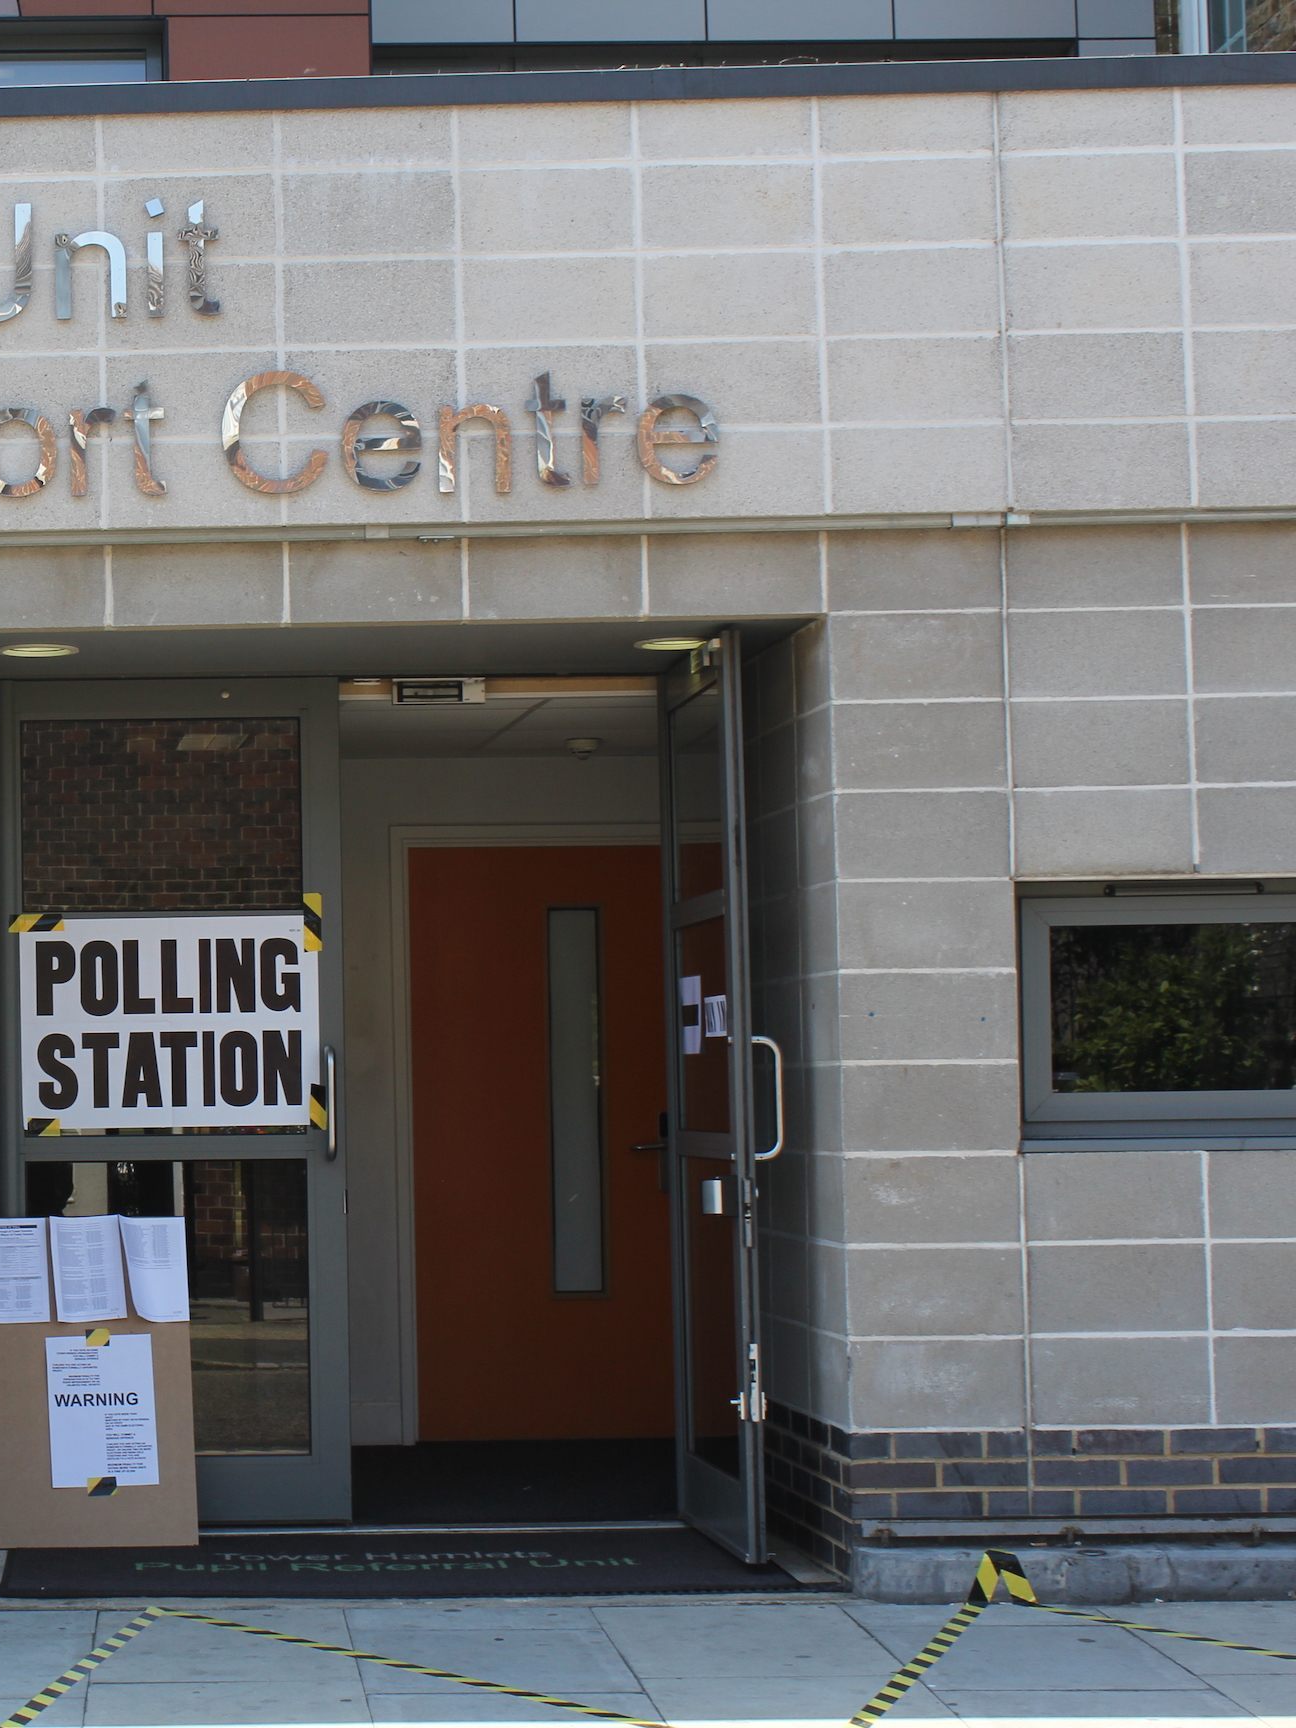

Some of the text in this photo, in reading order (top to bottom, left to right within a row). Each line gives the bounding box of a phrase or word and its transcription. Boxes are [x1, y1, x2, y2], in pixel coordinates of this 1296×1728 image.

[221, 369, 720, 495] Centre
[34, 937, 302, 1017] POLLING
[36, 1029, 304, 1111] STATION
[54, 1391, 139, 1408] WARNING
[134, 1556, 642, 1573] Pupil Referral Unit
[214, 1550, 553, 1561] Tower Hamlets
